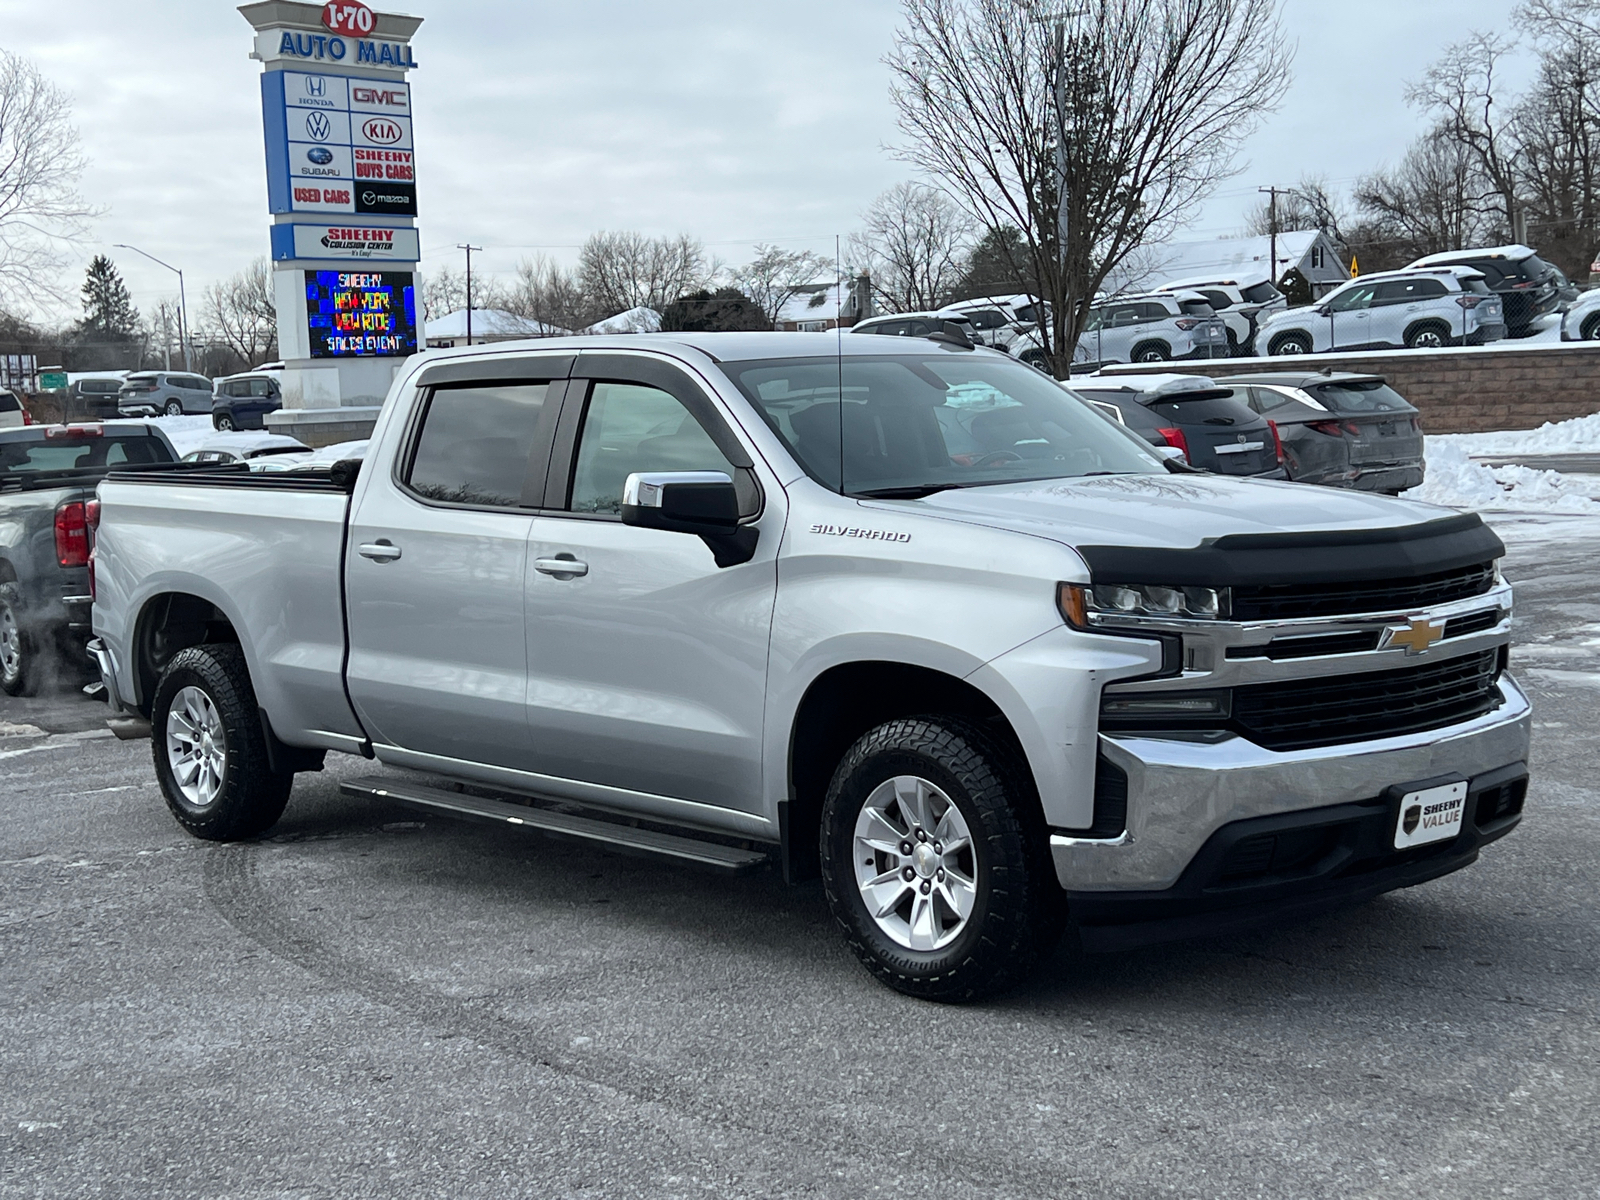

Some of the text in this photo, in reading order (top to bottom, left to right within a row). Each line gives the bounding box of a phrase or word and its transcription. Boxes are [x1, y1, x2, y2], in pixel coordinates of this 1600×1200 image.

[279, 31, 418, 68] AUTO MALL
[298, 97, 335, 107] HONDA
[353, 87, 407, 107] GMC
[369, 123, 396, 139] KIA
[355, 149, 411, 162] SHEEHY
[301, 167, 341, 176] SUBARU
[356, 162, 413, 180] BUYS CARS
[294, 188, 351, 204] USED CARS
[377, 194, 410, 204] mazda
[328, 228, 394, 241] SHEEHY
[329, 241, 393, 250] COLLISION CENTER
[338, 274, 382, 287] SHEEHY
[326, 335, 402, 351] SALES EVENT
[809, 523, 912, 543] SILVERADO
[1423, 798, 1463, 816] SHEEHY
[1422, 810, 1461, 829] VALUE
